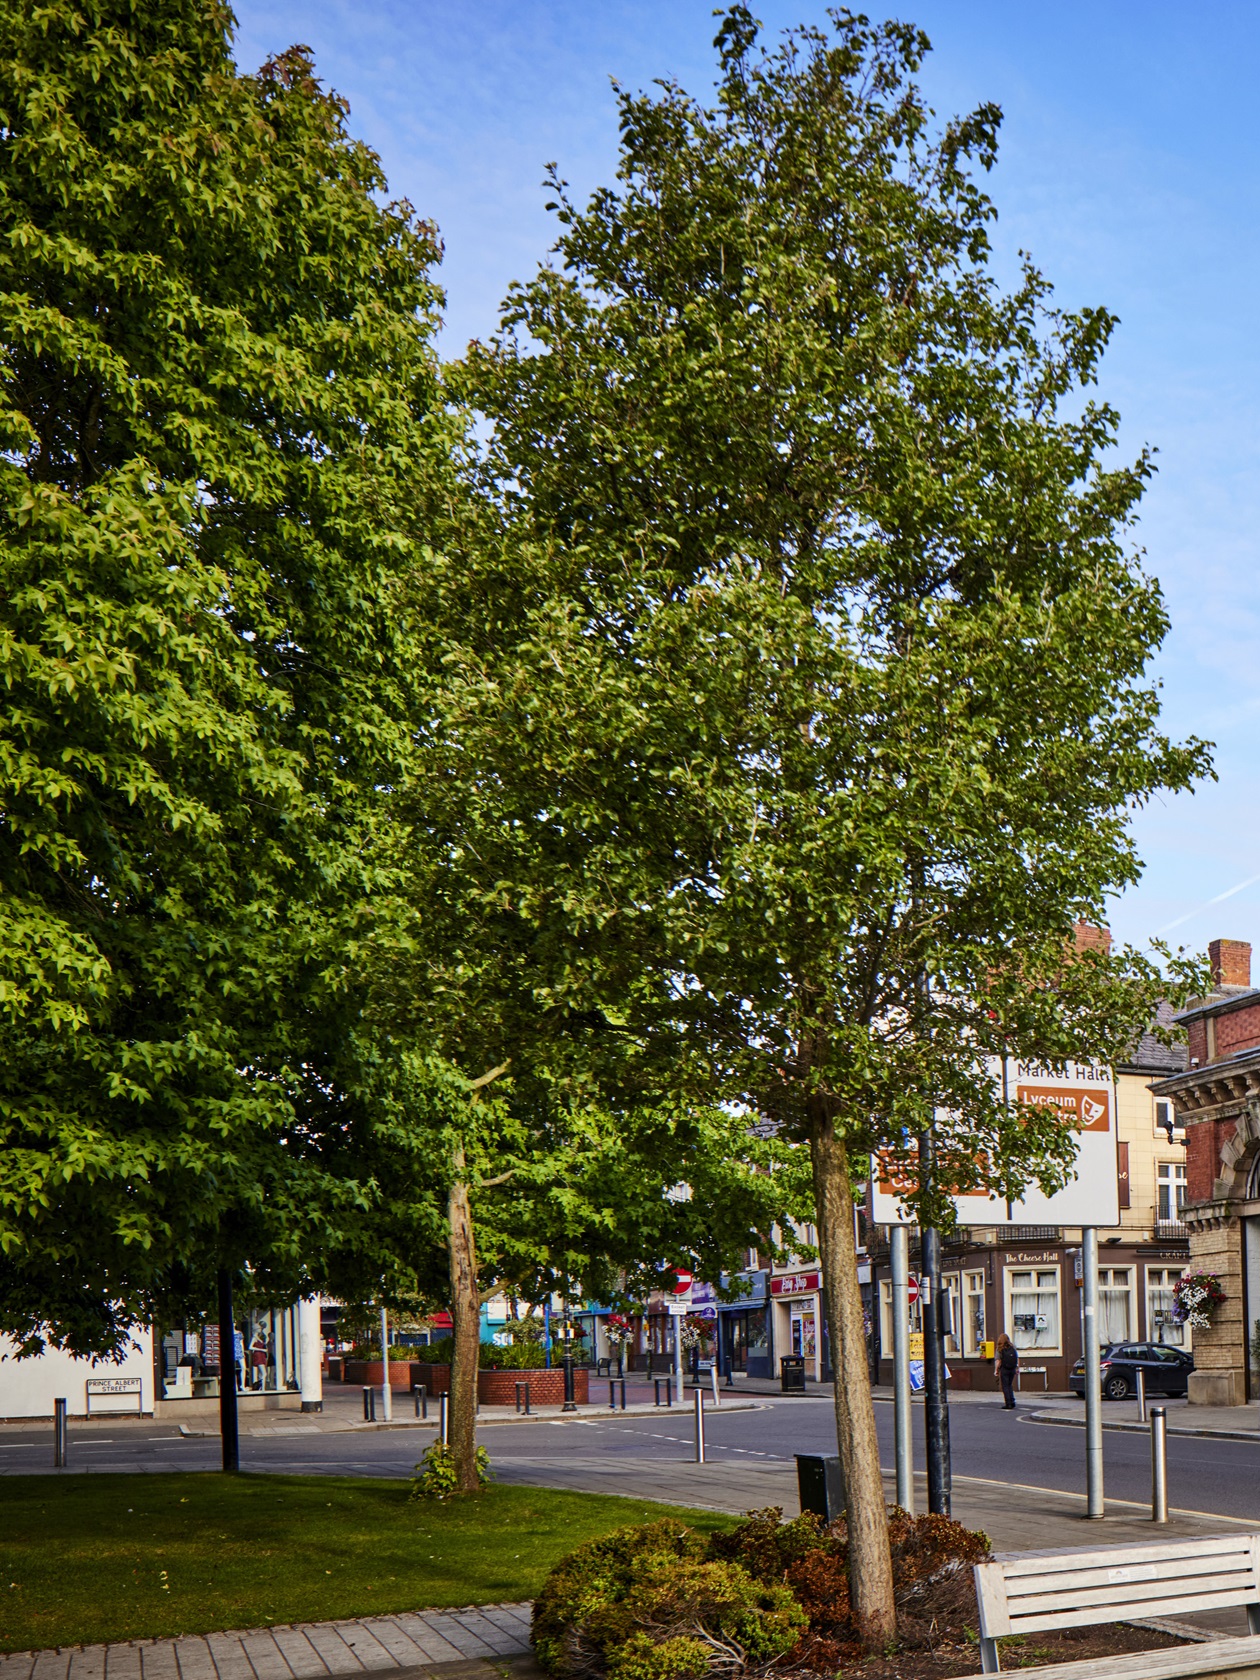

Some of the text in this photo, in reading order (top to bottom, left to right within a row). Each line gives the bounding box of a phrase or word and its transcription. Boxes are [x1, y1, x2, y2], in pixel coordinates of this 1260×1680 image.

[1018, 1063, 1069, 1079] Market
[1024, 1091, 1076, 1107] Lyceum
[1004, 1252, 1058, 1263] The Cheese Hall
